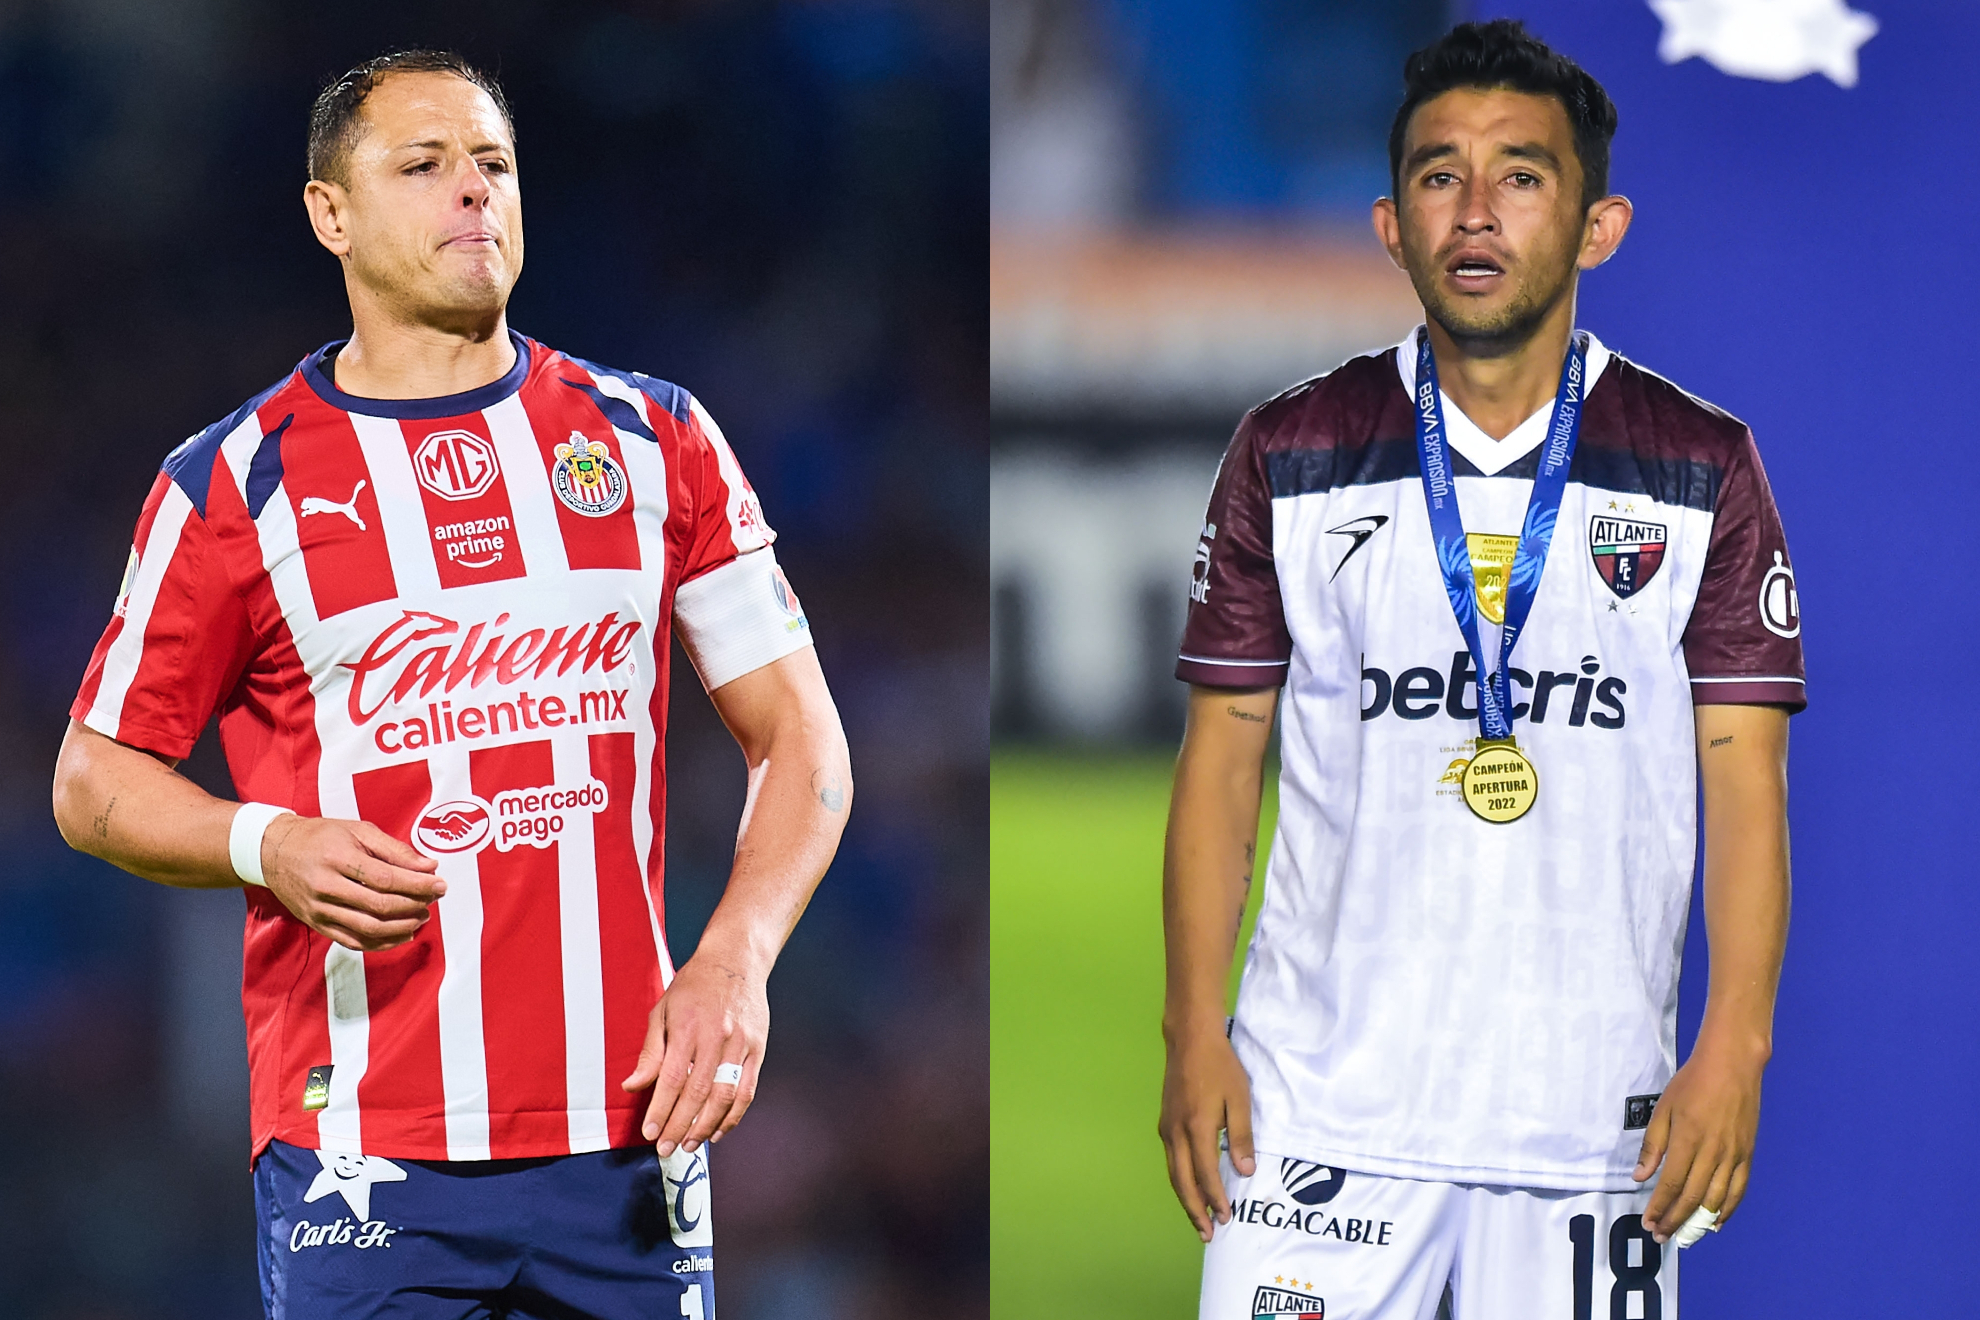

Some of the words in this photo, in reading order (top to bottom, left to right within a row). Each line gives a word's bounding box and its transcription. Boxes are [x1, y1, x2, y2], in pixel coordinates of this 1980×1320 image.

[1565, 355, 1581, 403] BBVA
[1419, 382, 1438, 433] BBVA
[421, 435, 491, 494] MG
[434, 516, 510, 540] amazon
[1594, 520, 1662, 543] ATLANTE
[446, 536, 505, 561] prime
[1471, 554, 1513, 563] CAMPEO
[1487, 575, 1507, 590] 202
[1616, 583, 1631, 591] 1916
[336, 610, 641, 726] Caliente
[1361, 651, 1627, 730] betcris
[374, 688, 629, 754] caliente.mx
[1473, 760, 1524, 776] CAMPEÓN
[500, 784, 604, 816] mercado
[1473, 779, 1528, 795] APERTURA
[1488, 797, 1516, 811] 2022
[501, 814, 564, 844] pago
[290, 1217, 355, 1252] Carl's
[354, 1221, 397, 1249] Jr.
[1230, 1198, 1393, 1246] MEGACABLE
[1569, 1213, 1662, 1320] 18
[1257, 1291, 1319, 1313] ATLANTE
